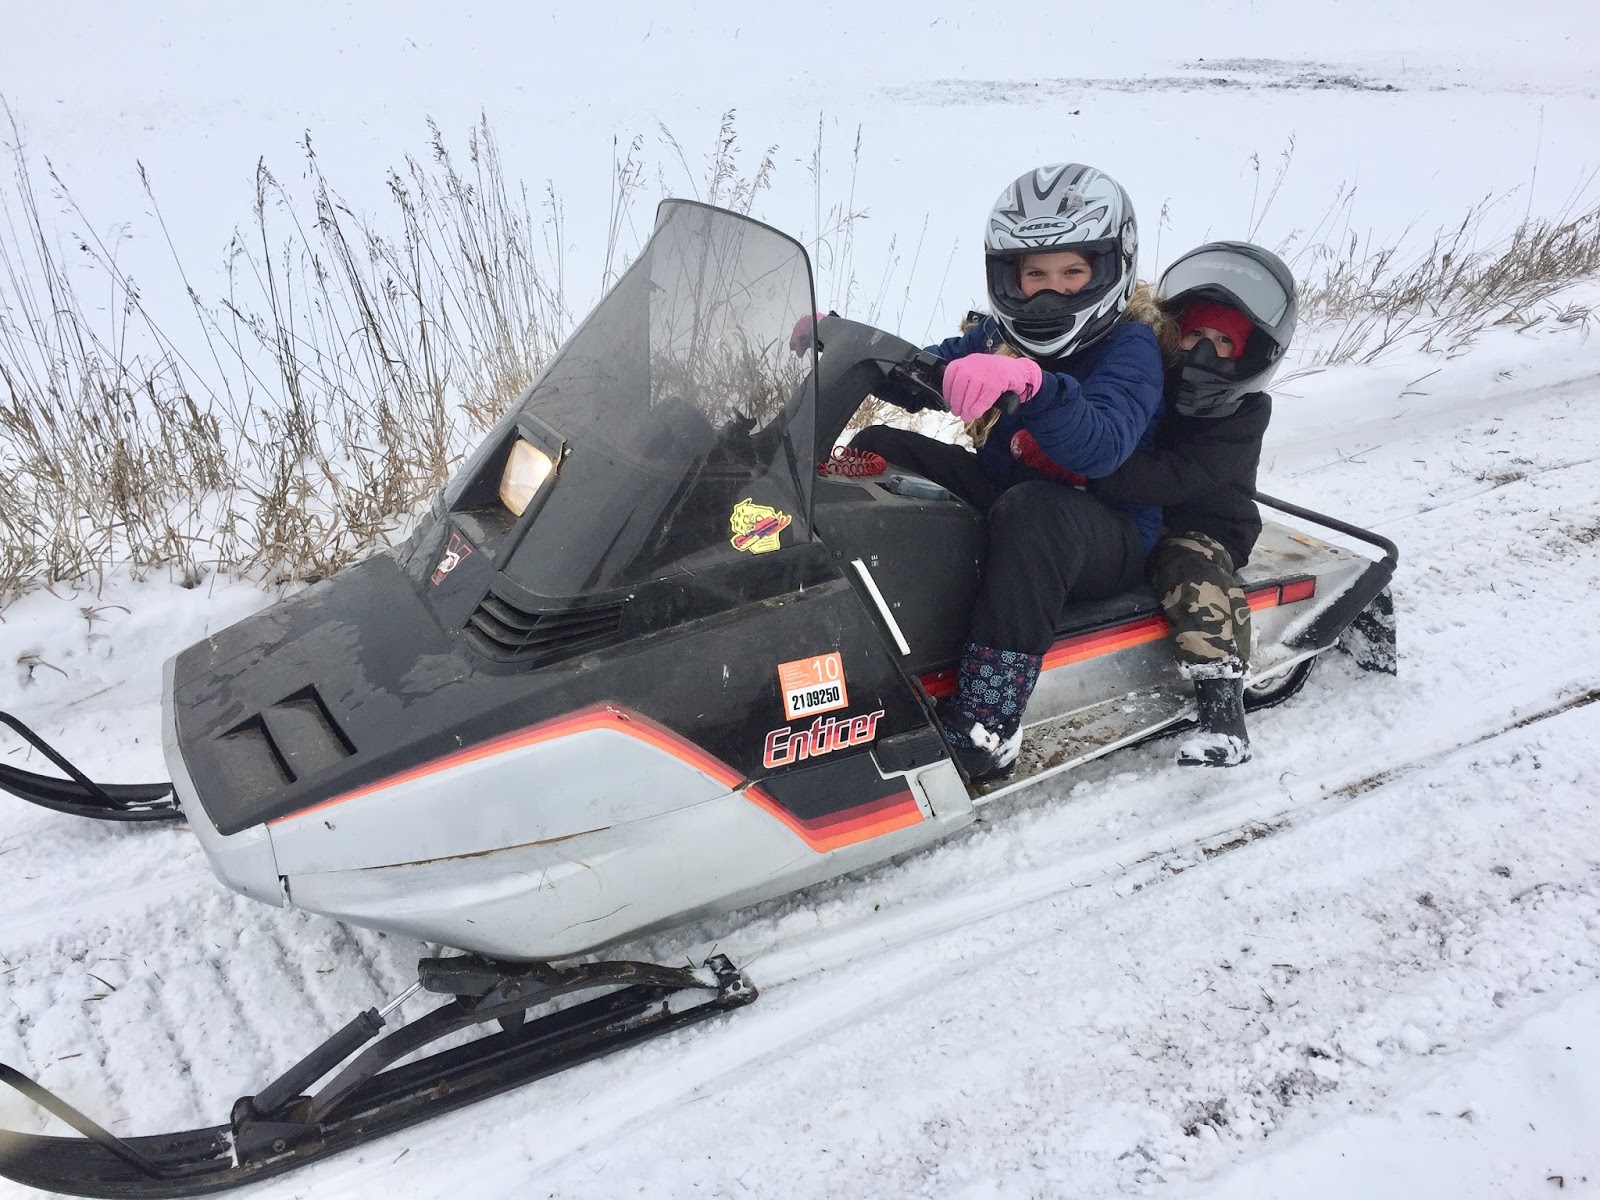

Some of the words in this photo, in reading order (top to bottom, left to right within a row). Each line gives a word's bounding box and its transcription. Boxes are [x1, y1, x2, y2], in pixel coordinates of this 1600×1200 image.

[1019, 222, 1067, 233] KBC
[812, 656, 839, 682] 10
[792, 686, 840, 710] 2109250
[763, 709, 885, 769] Enticer
